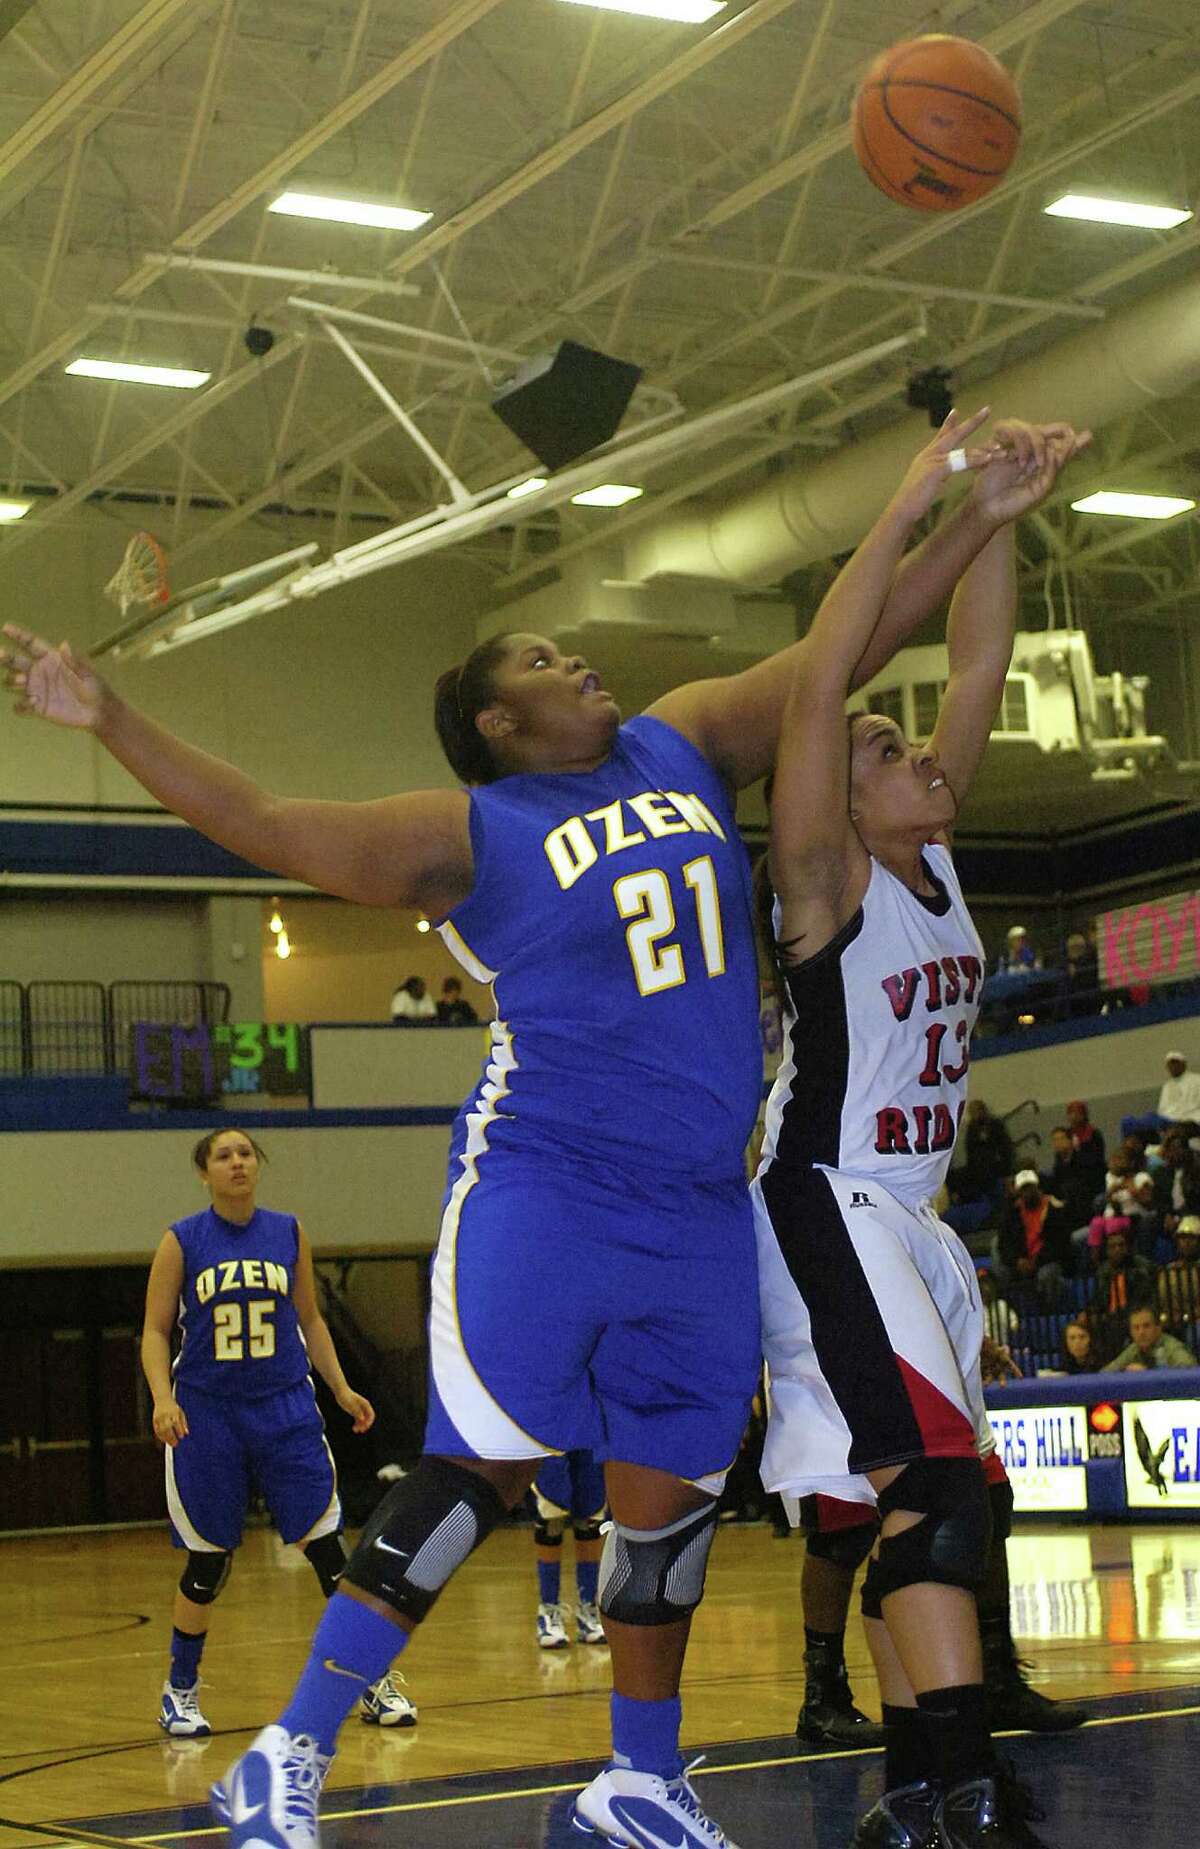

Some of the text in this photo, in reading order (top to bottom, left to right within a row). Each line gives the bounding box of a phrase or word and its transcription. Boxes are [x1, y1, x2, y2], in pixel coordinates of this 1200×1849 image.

[544, 789, 727, 890] OZEN
[613, 855, 726, 997] 21
[881, 956, 983, 1022] VIST
[874, 1100, 966, 1155] RID
[196, 1260, 288, 1304] OZEN
[213, 1299, 275, 1361] 25
[1035, 1416, 1082, 1467] HILL
[1172, 1428, 1200, 1482] E
